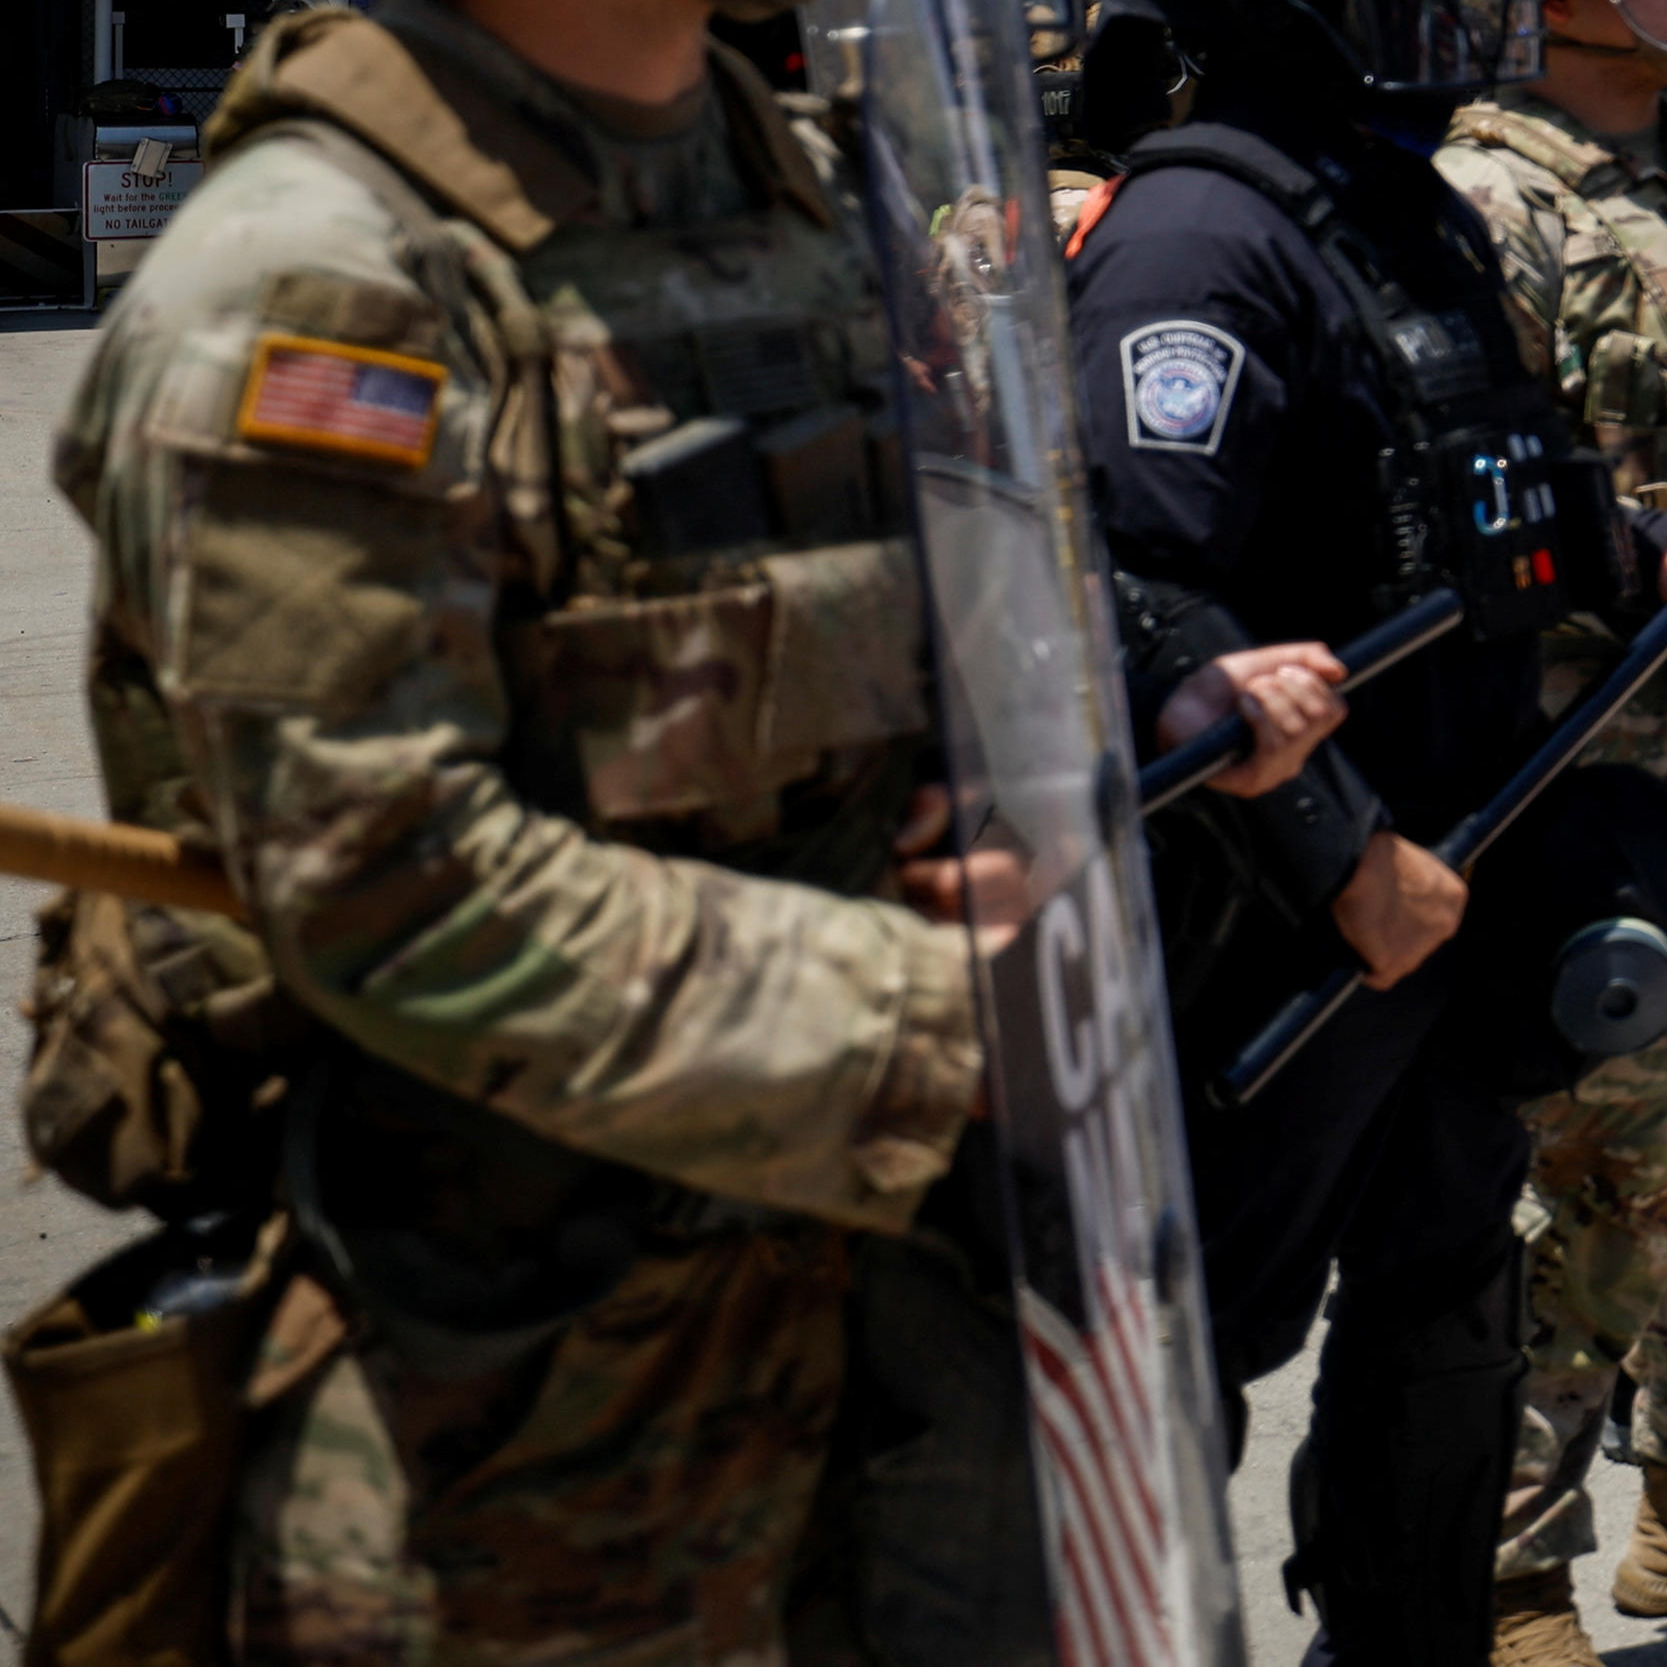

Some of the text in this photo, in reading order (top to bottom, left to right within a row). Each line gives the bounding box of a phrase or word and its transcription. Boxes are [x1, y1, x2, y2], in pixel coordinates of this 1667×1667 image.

[121, 172, 173, 188] STOP!
[104, 193, 122, 202] Wait
[126, 193, 138, 202] for
[141, 193, 156, 202] the
[93, 204, 115, 215] light
[118, 203, 146, 213] before
[105, 218, 168, 230] NO TAILGAT
